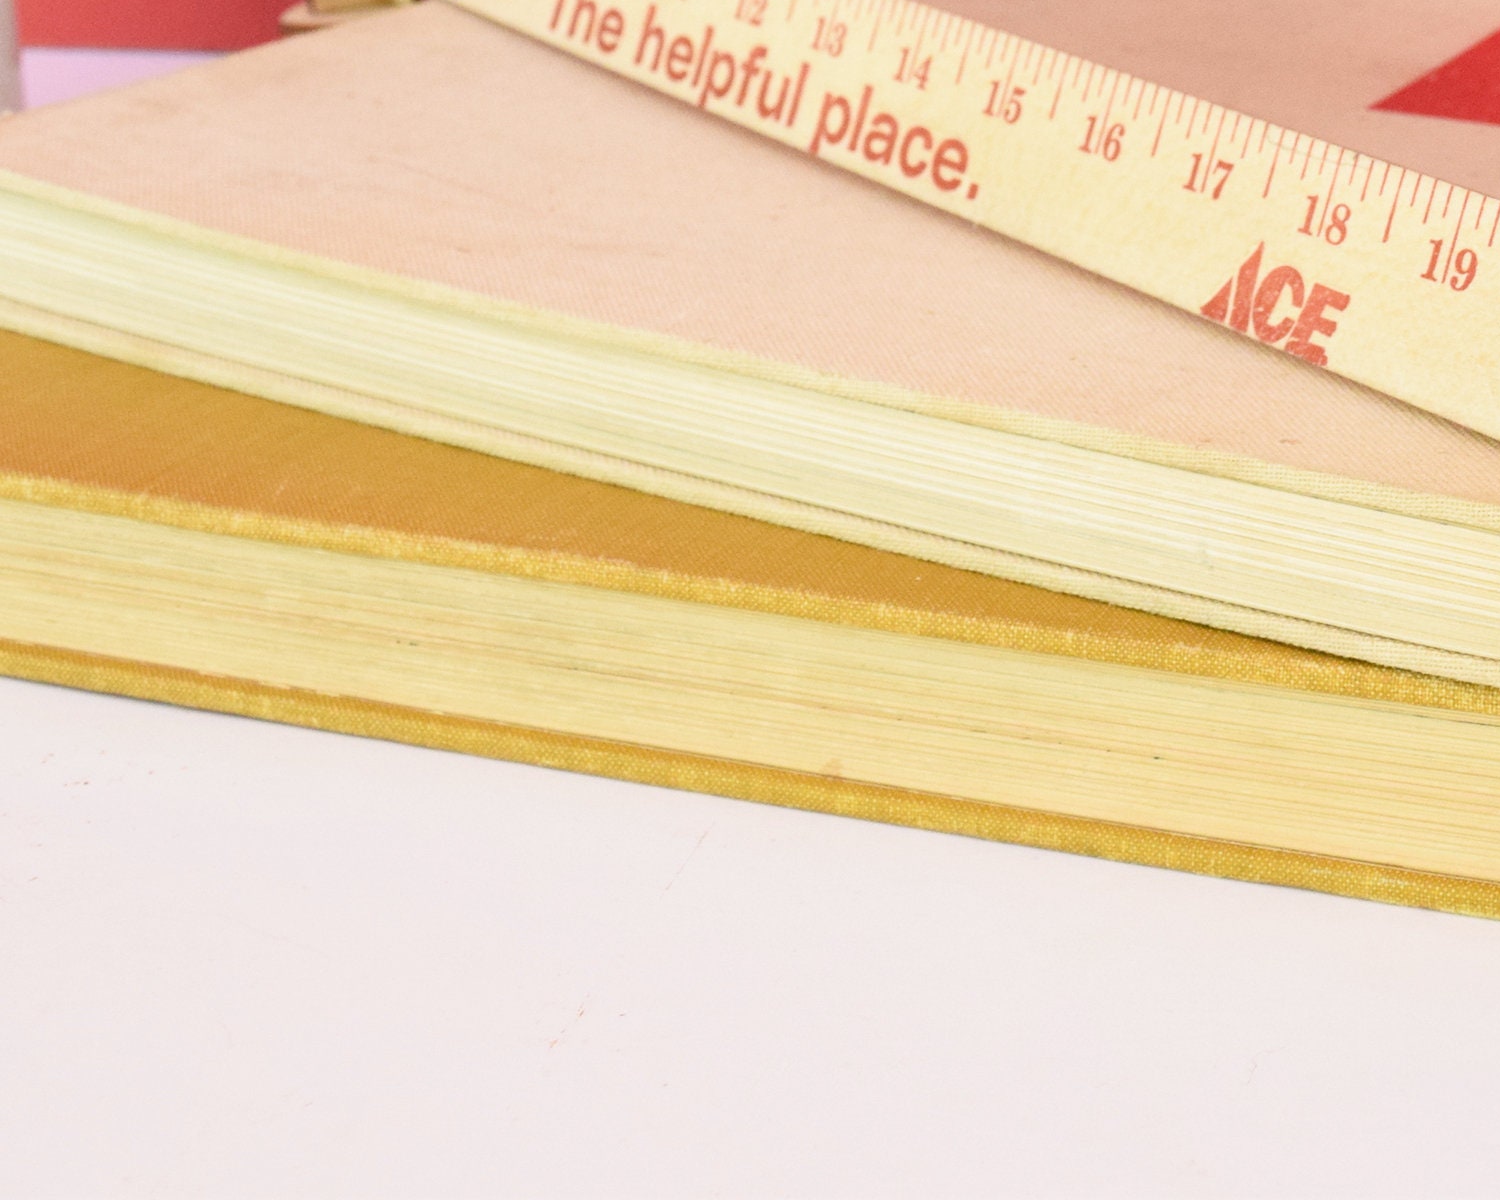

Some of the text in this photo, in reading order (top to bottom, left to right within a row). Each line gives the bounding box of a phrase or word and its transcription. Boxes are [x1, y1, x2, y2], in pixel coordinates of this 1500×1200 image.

[635, 4, 811, 128] helpful
[809, 85, 981, 200] place.
[812, 17, 848, 57] 13
[893, 47, 932, 90] 14
[983, 80, 1028, 125] 15
[1078, 115, 1126, 162] 16
[1182, 153, 1235, 201] 17
[1297, 195, 1352, 246] 18
[1420, 238, 1479, 292] 19
[1200, 241, 1351, 367] ACE
